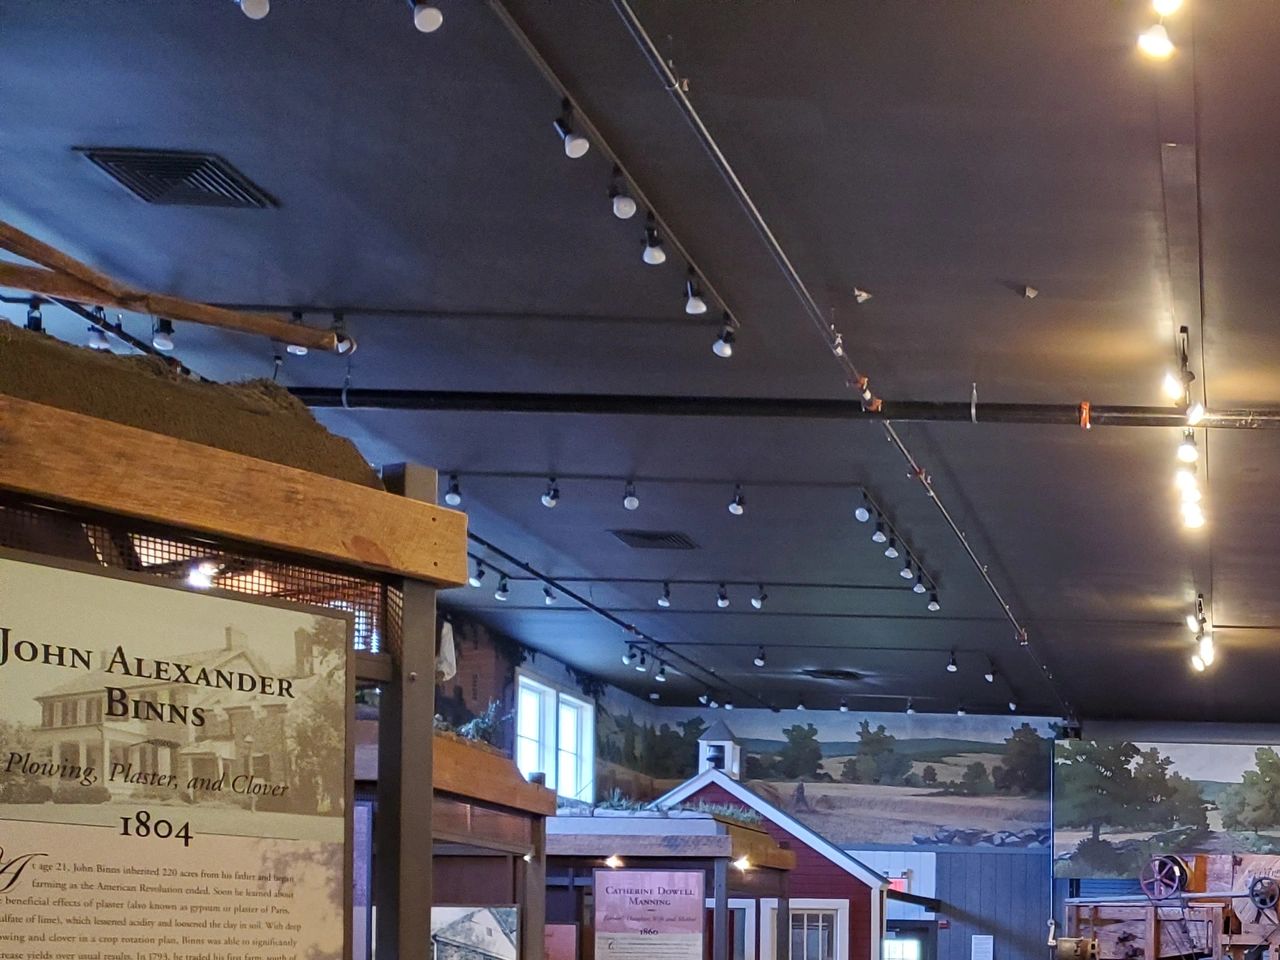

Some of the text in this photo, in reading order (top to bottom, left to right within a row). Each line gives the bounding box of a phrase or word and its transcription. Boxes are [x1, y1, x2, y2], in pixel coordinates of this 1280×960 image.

[0, 627, 296, 698] JOHN ALEXANDER
[106, 686, 206, 727] BINNS
[5, 752, 289, 798] Plowing, Plaster, and Clover
[120, 810, 194, 847] 1804
[73, 861, 93, 875] John
[96, 862, 120, 874] Binns
[122, 863, 160, 875] inherited
[180, 869, 198, 877] acres
[200, 866, 218, 878] from
[234, 868, 254, 880] father
[32, 876, 294, 898] farming American Revolution ended. Soon learned about
[605, 886, 653, 895] CATHERINE
[4, 893, 50, 906] beneficial
[52, 895, 81, 907] effects
[95, 896, 123, 911] plaster
[126, 897, 146, 912] (also
[148, 898, 176, 910] known
[189, 903, 220, 914] gypsum
[233, 901, 258, 916] plaster
[628, 897, 671, 906] MANNING
[37, 912, 62, 927] lime),
[65, 913, 91, 925] which
[93, 914, 126, 926] lessened
[129, 915, 154, 929] acidity
[174, 916, 207, 928] loosened
[223, 917, 236, 932] clay
[48, 931, 75, 942] clover
[98, 936, 118, 946] crop
[120, 934, 155, 944] rotation
[157, 933, 176, 947] plan,
[181, 933, 204, 945] Binns
[224, 934, 239, 945] able
[77, 949, 100, 960] usual
